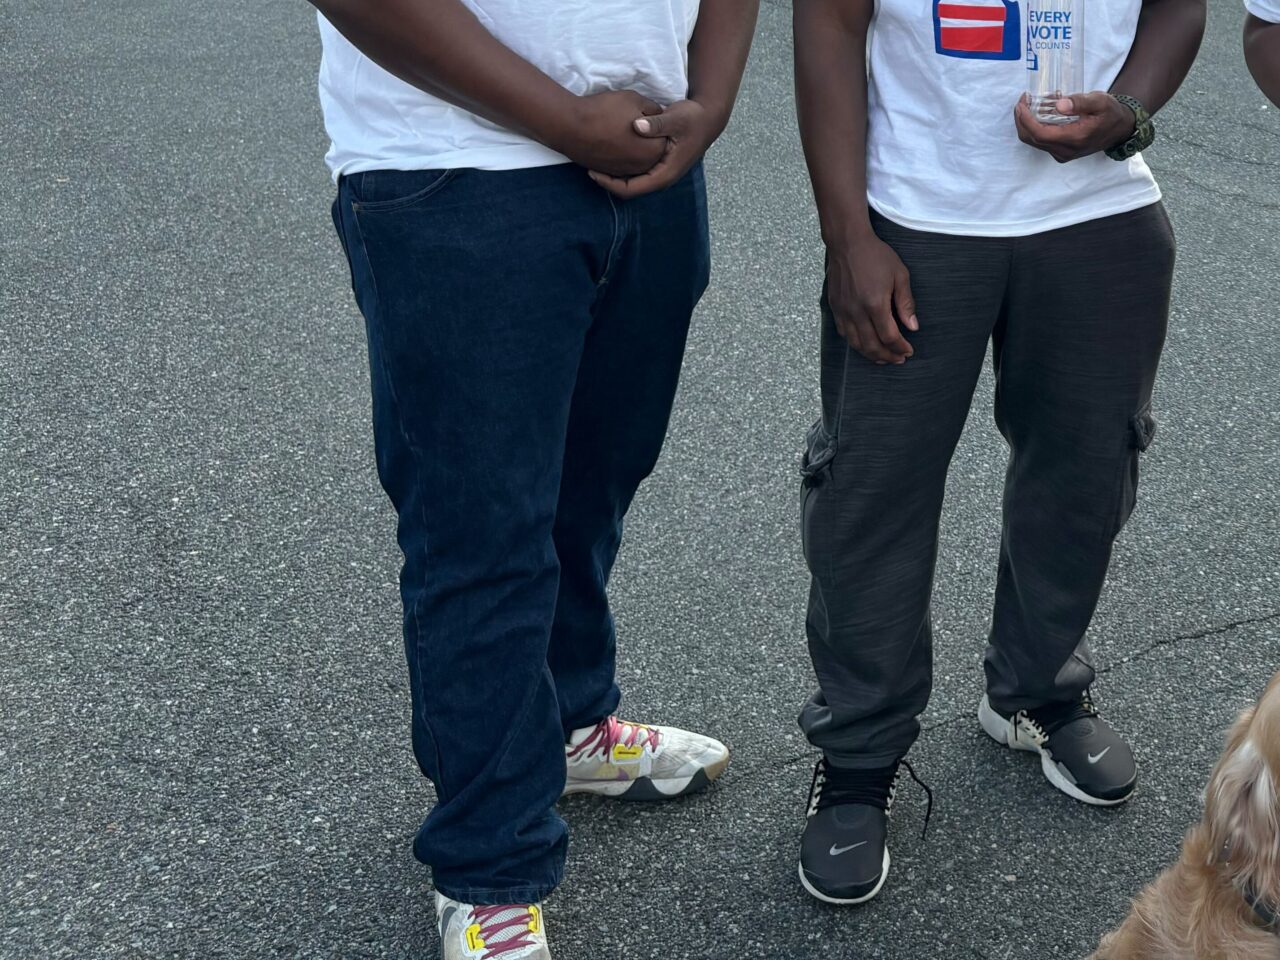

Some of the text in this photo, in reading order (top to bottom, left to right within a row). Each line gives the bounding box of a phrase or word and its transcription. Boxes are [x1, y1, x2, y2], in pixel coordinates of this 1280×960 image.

[1030, 10, 1072, 23] EVERY
[1030, 25, 1072, 40] VOTE
[1035, 41, 1071, 50] COUNTS
